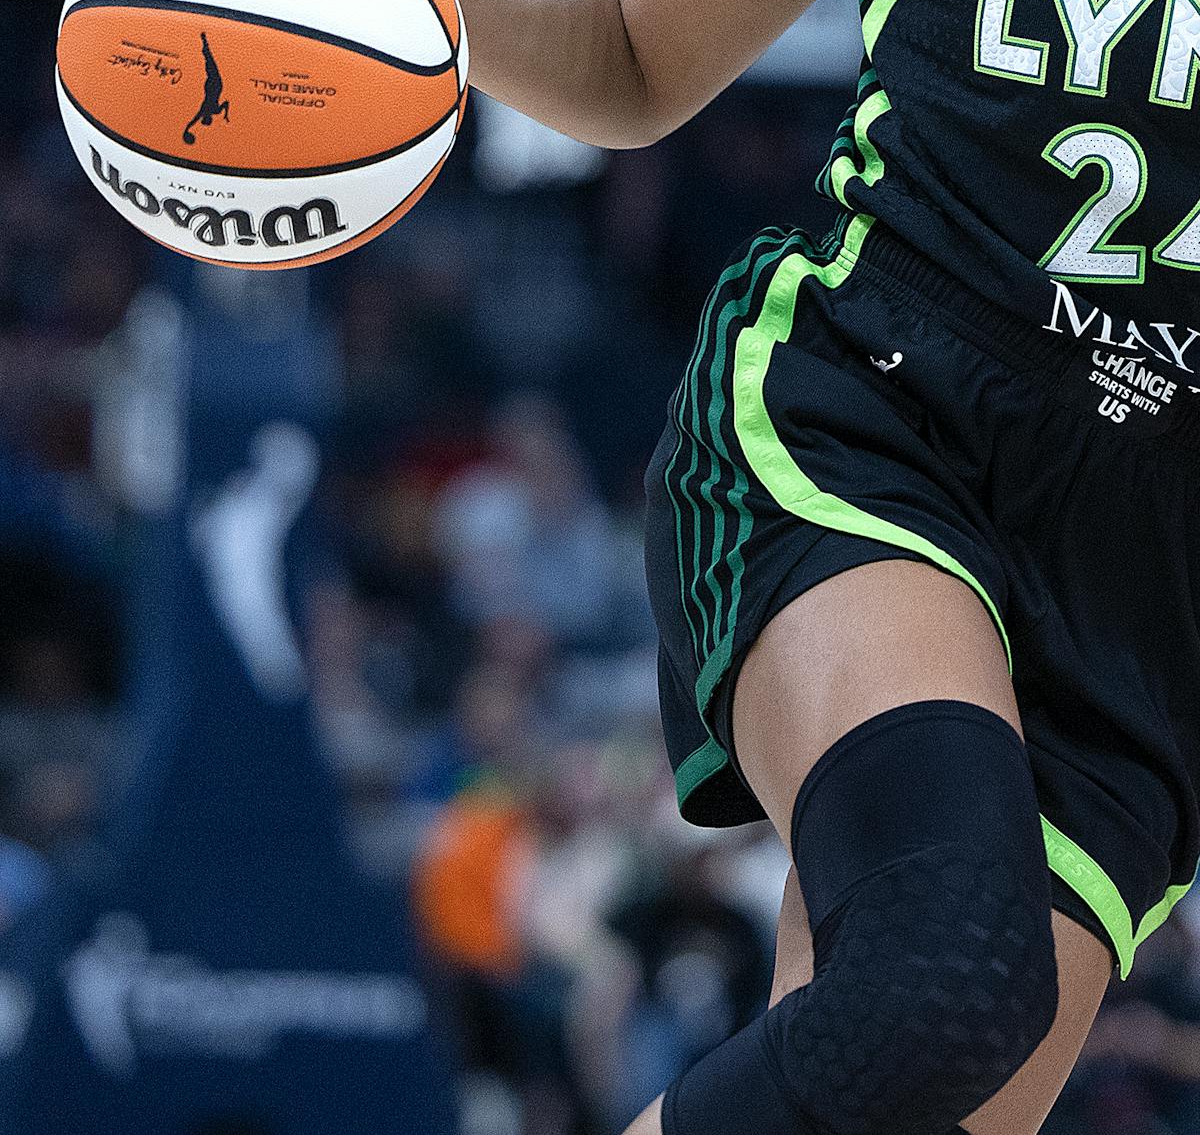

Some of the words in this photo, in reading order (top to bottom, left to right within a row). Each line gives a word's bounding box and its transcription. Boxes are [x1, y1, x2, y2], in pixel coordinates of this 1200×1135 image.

[248, 78, 289, 92] BALL
[292, 84, 337, 97] GAME
[257, 93, 326, 109] OFFICIAL
[88, 143, 348, 248] Wilson
[168, 181, 198, 195] NXT
[204, 189, 235, 199] EVO
[1092, 350, 1178, 404] CHANGE
[1088, 370, 1133, 400] STARTS
[1130, 391, 1161, 416] WITH
[1097, 395, 1132, 424] US
